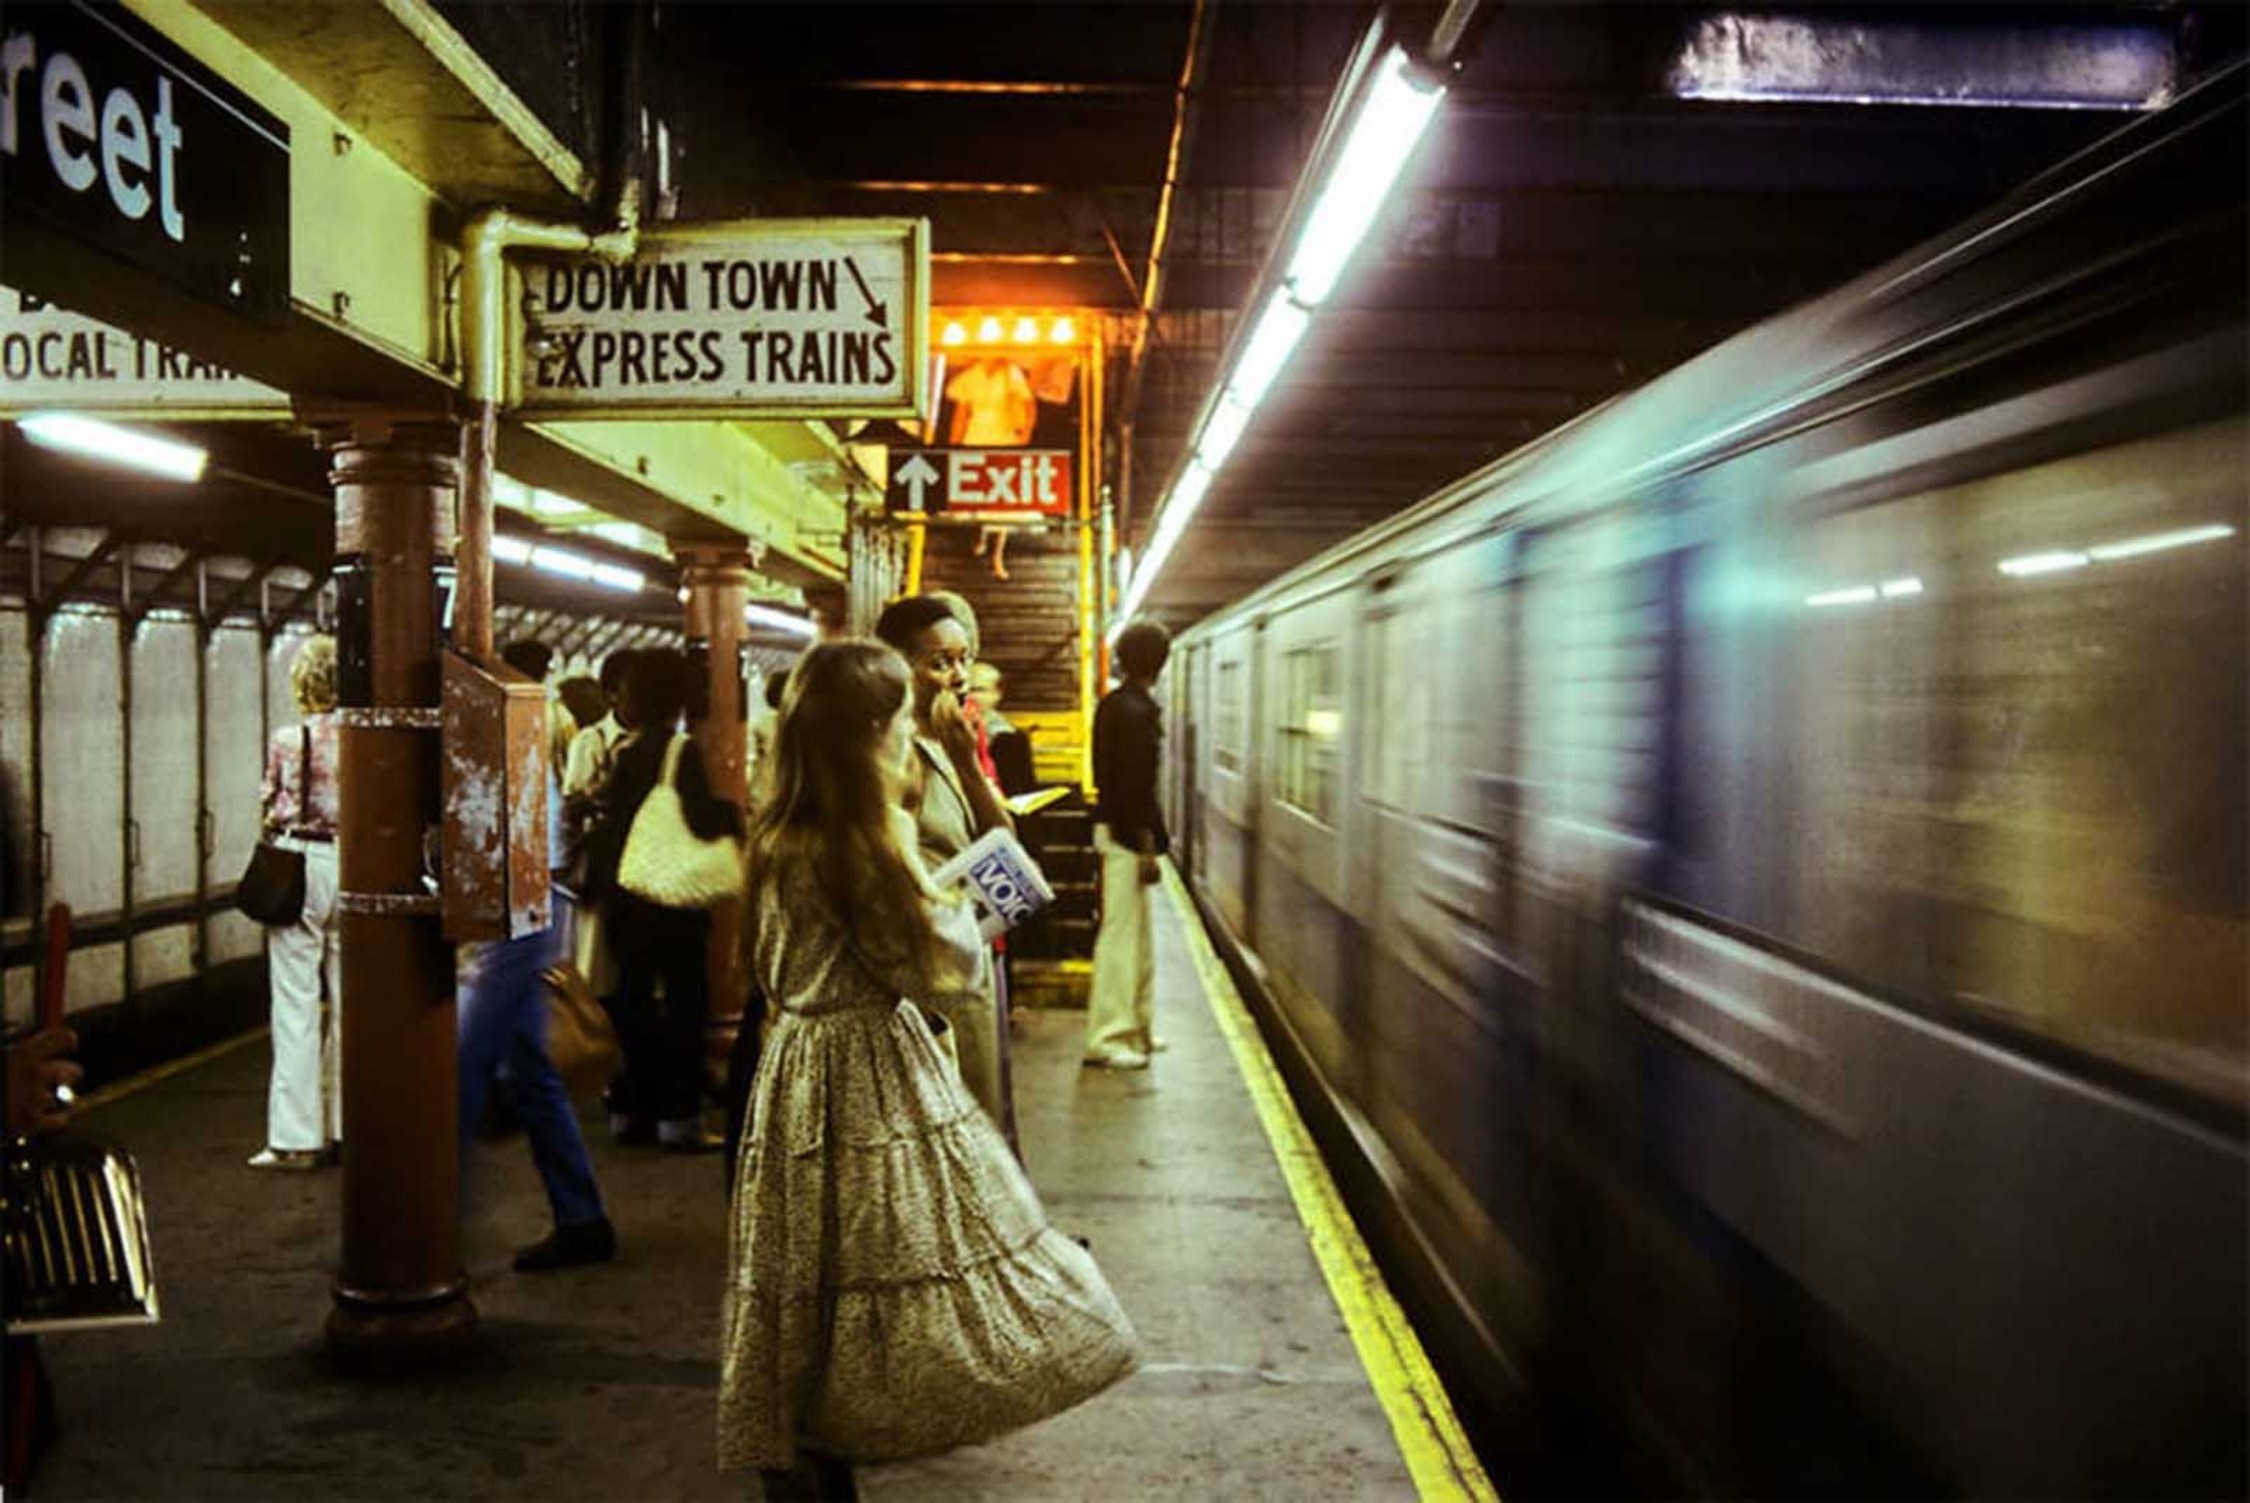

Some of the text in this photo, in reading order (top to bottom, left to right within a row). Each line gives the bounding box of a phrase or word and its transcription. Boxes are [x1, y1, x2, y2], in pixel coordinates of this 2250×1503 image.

[546, 260, 837, 314] DOWN TOWN
[537, 330, 896, 388] EXPRESS TRAINS
[949, 453, 1058, 504] Exit
